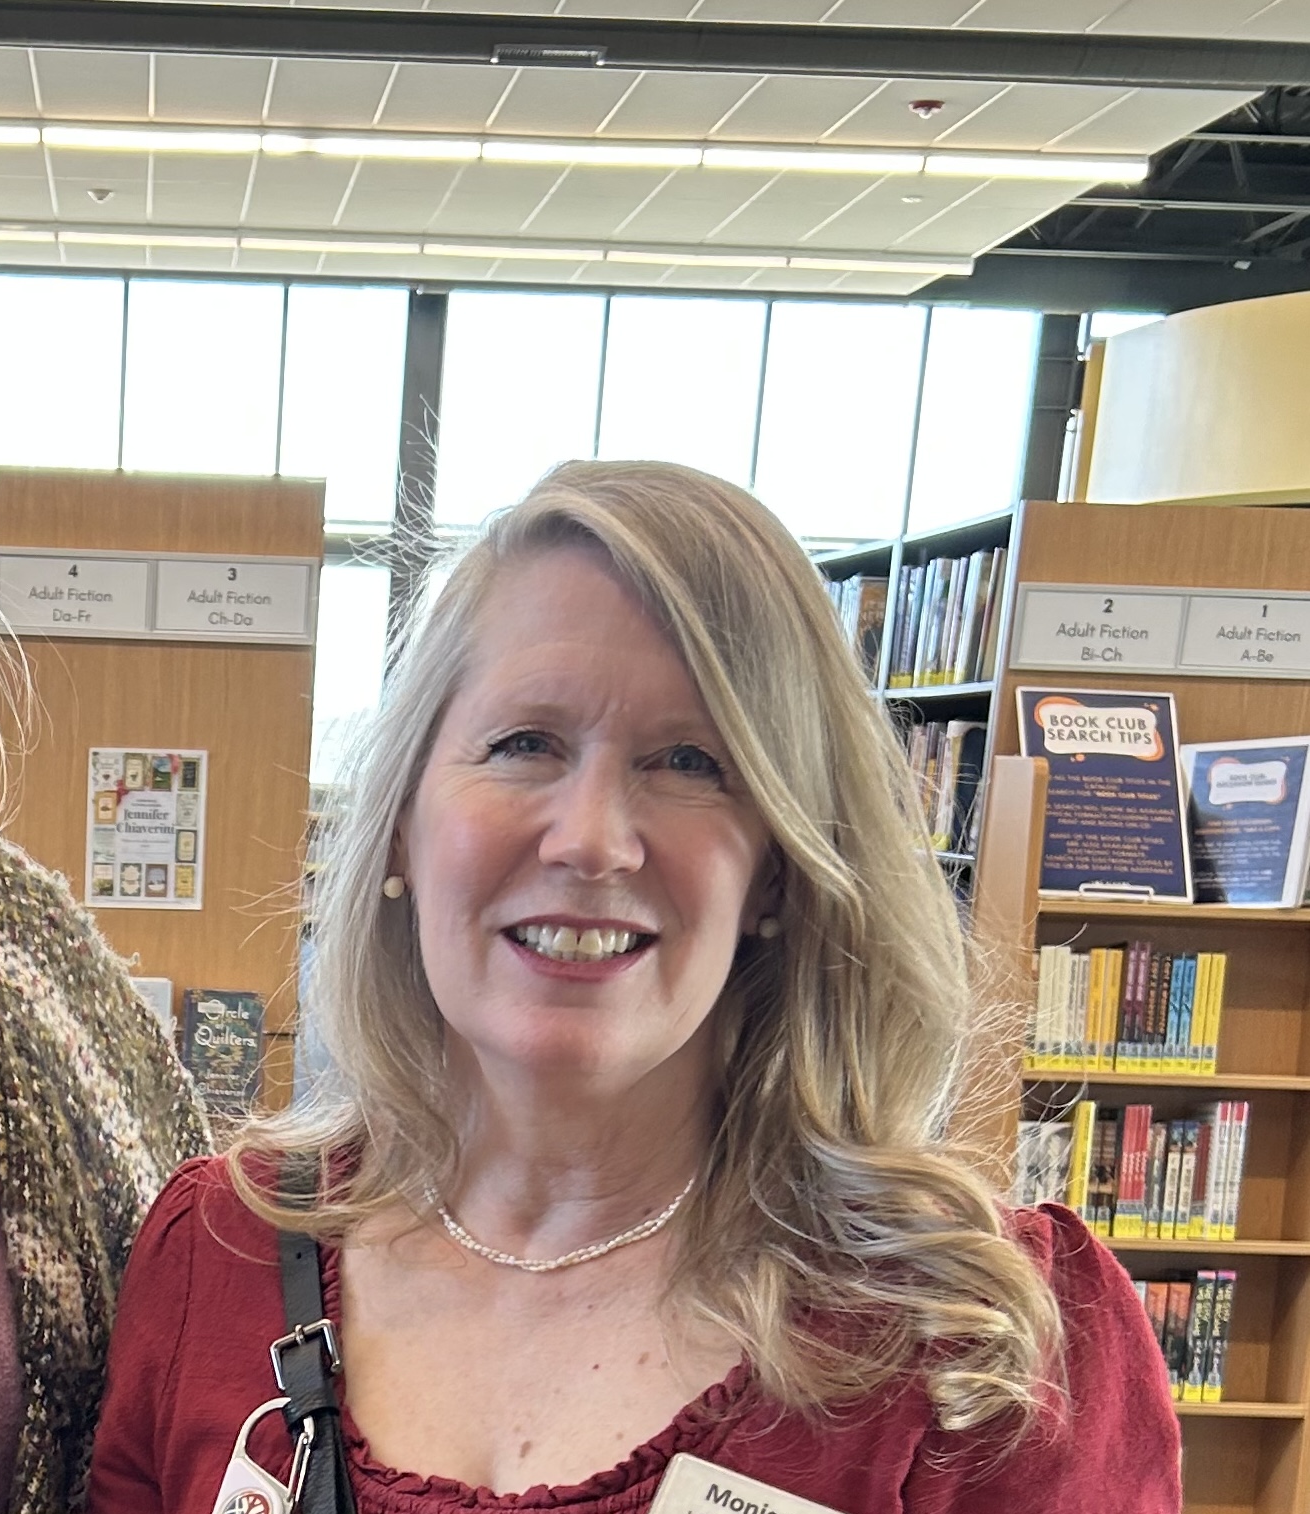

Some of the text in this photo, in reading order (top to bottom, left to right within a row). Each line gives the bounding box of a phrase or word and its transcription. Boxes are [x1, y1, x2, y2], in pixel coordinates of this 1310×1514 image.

[68, 564, 78, 578] 4
[227, 567, 237, 581] 3
[28, 586, 113, 602] Adult Fiction
[187, 590, 272, 605] Adult Fiction
[1103, 598, 1114, 613] 2
[1261, 603, 1269, 618] 1
[52, 608, 92, 622] Da-Fr
[208, 611, 254, 626] Ch-Da
[1056, 621, 1149, 641] Adult Fiction
[1215, 625, 1302, 643] Adult Fiction
[1080, 646, 1122, 662] Bi-Ch
[1239, 648, 1274, 663] A-Be
[1049, 714, 1147, 731] BOOK CLUB
[1047, 728, 1152, 746] SEARCH TIPS
[124, 808, 169, 821] Jennifer
[116, 822, 176, 835] Chiaverini
[194, 1025, 257, 1049] Quilters
